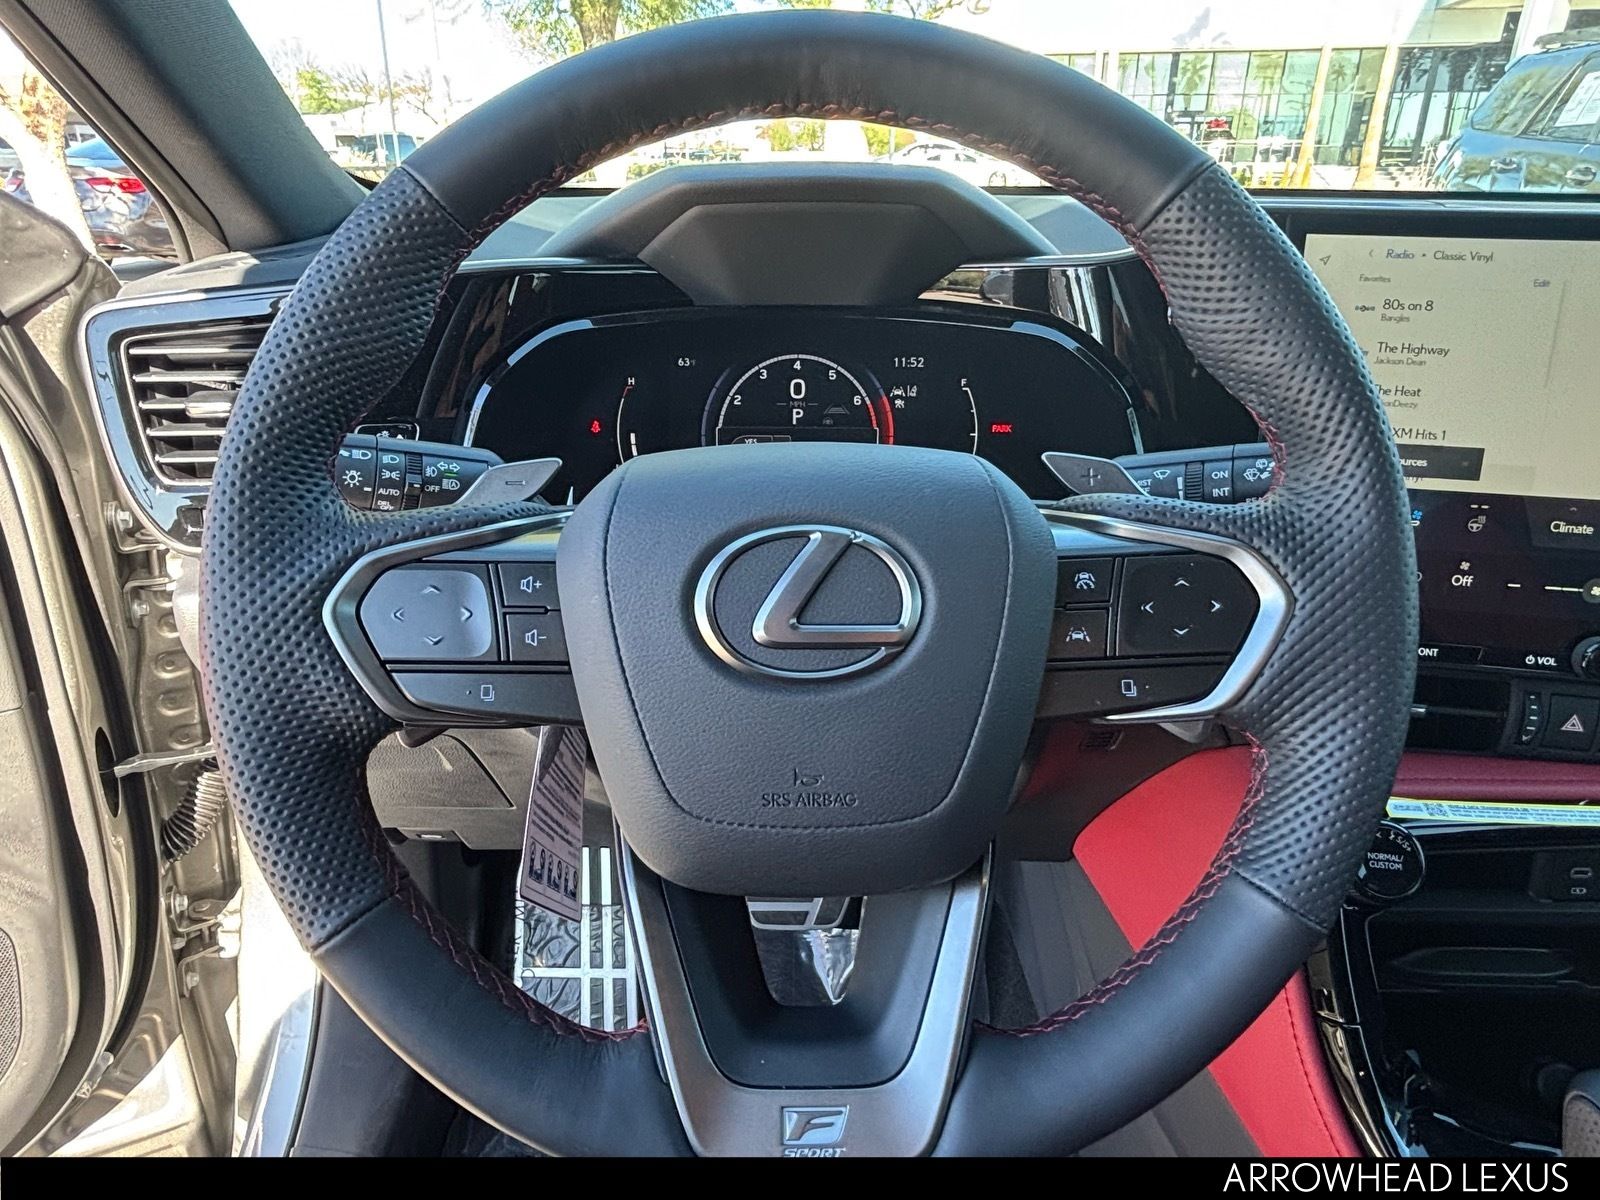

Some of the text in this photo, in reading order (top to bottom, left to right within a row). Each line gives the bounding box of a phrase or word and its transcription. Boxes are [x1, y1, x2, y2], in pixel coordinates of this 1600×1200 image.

[1385, 249, 1494, 264] Radio Classic Vinyl
[1382, 298, 1405, 311] 80s
[1407, 303, 1422, 311] on
[1424, 299, 1434, 312] 8
[1377, 341, 1450, 358] The Highway
[793, 360, 802, 371] 4
[893, 357, 925, 368] 11:52
[759, 369, 768, 380] 3
[828, 370, 837, 380] 5
[627, 377, 635, 386] H
[961, 378, 967, 386] F
[1394, 385, 1422, 398] Heat
[733, 395, 742, 405] 2
[853, 395, 862, 406] 6
[792, 408, 804, 425] P
[991, 424, 1013, 433] PARK
[1415, 428, 1438, 441] Hits
[1442, 430, 1447, 441] 1
[1399, 458, 1428, 467] ources
[1211, 469, 1229, 480] ON
[378, 487, 400, 496] AUTO
[1211, 486, 1230, 498] INT
[1550, 520, 1594, 536] Climate
[1451, 574, 1474, 587] Off
[1537, 656, 1558, 666] VOL
[762, 792, 859, 808] SRS AIRBAG
[1367, 851, 1404, 862] NORMAL/
[1369, 860, 1403, 871] CUSTOM
